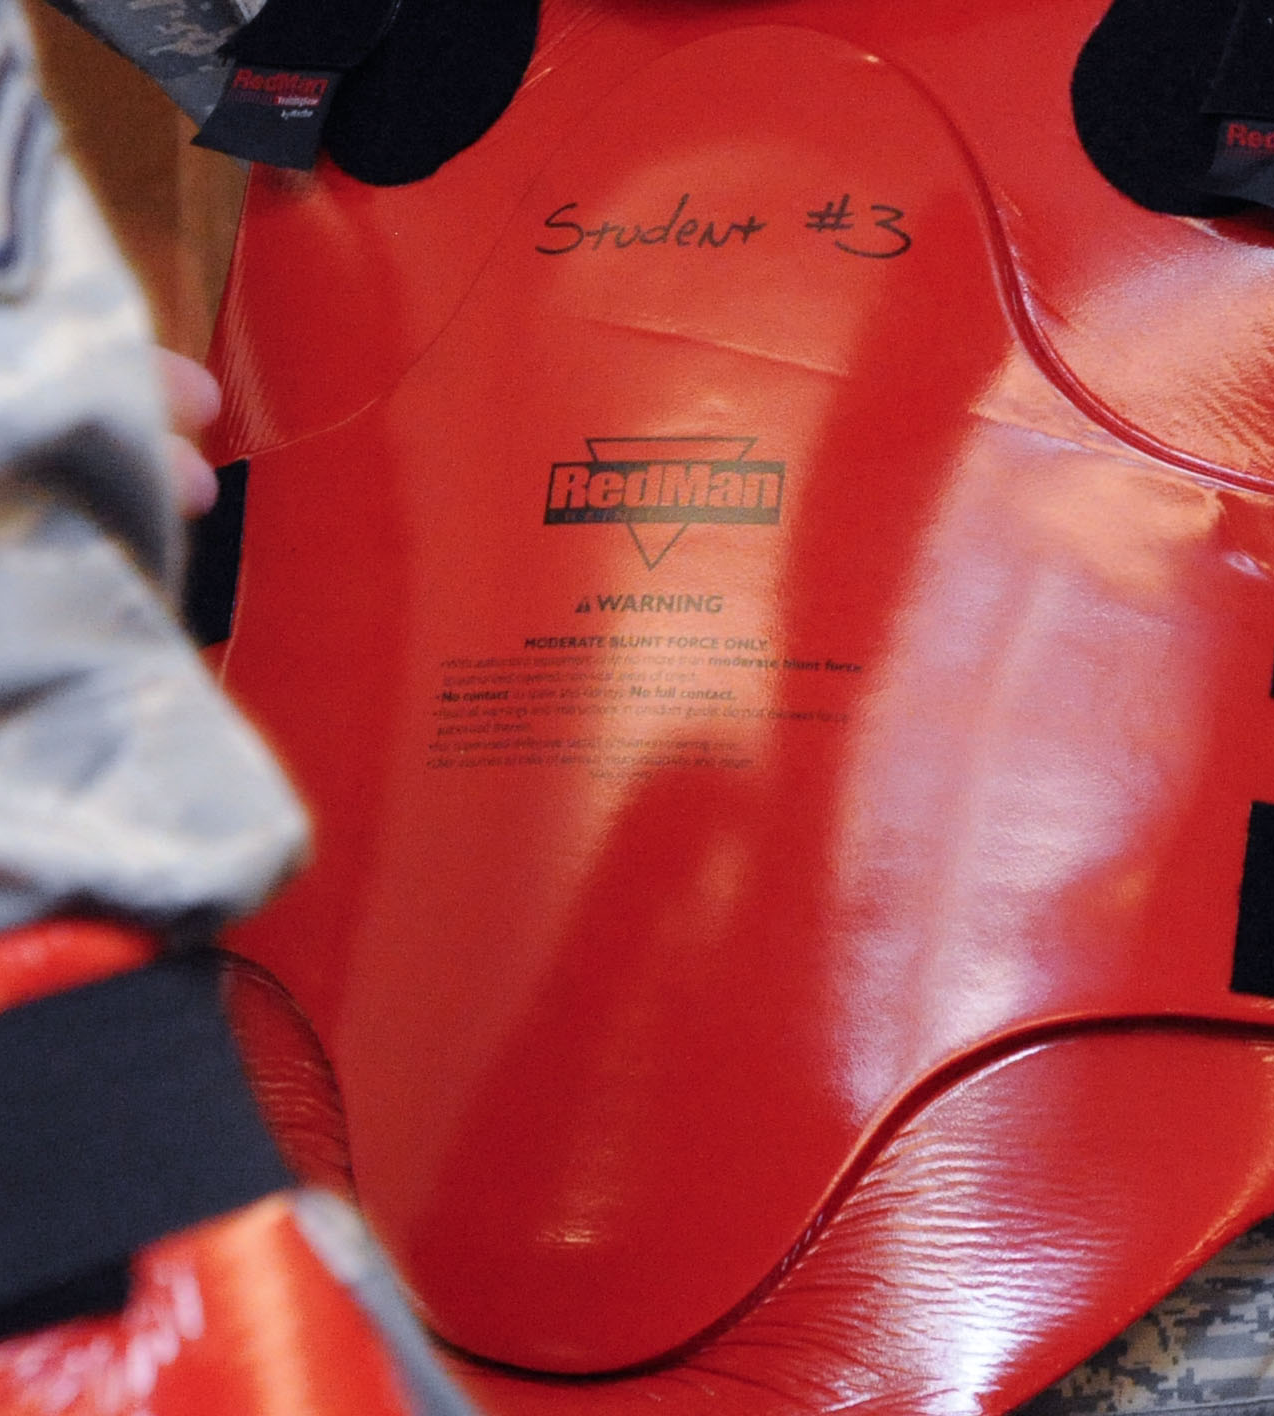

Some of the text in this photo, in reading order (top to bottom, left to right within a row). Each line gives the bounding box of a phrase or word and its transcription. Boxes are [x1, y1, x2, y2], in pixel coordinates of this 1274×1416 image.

[232, 68, 329, 94] RedMan
[534, 192, 913, 259] Student #3
[547, 462, 780, 510] RedMan
[596, 594, 723, 614] WARNING
[524, 635, 769, 652] MODERATE BLUNT FORCE ONLY
